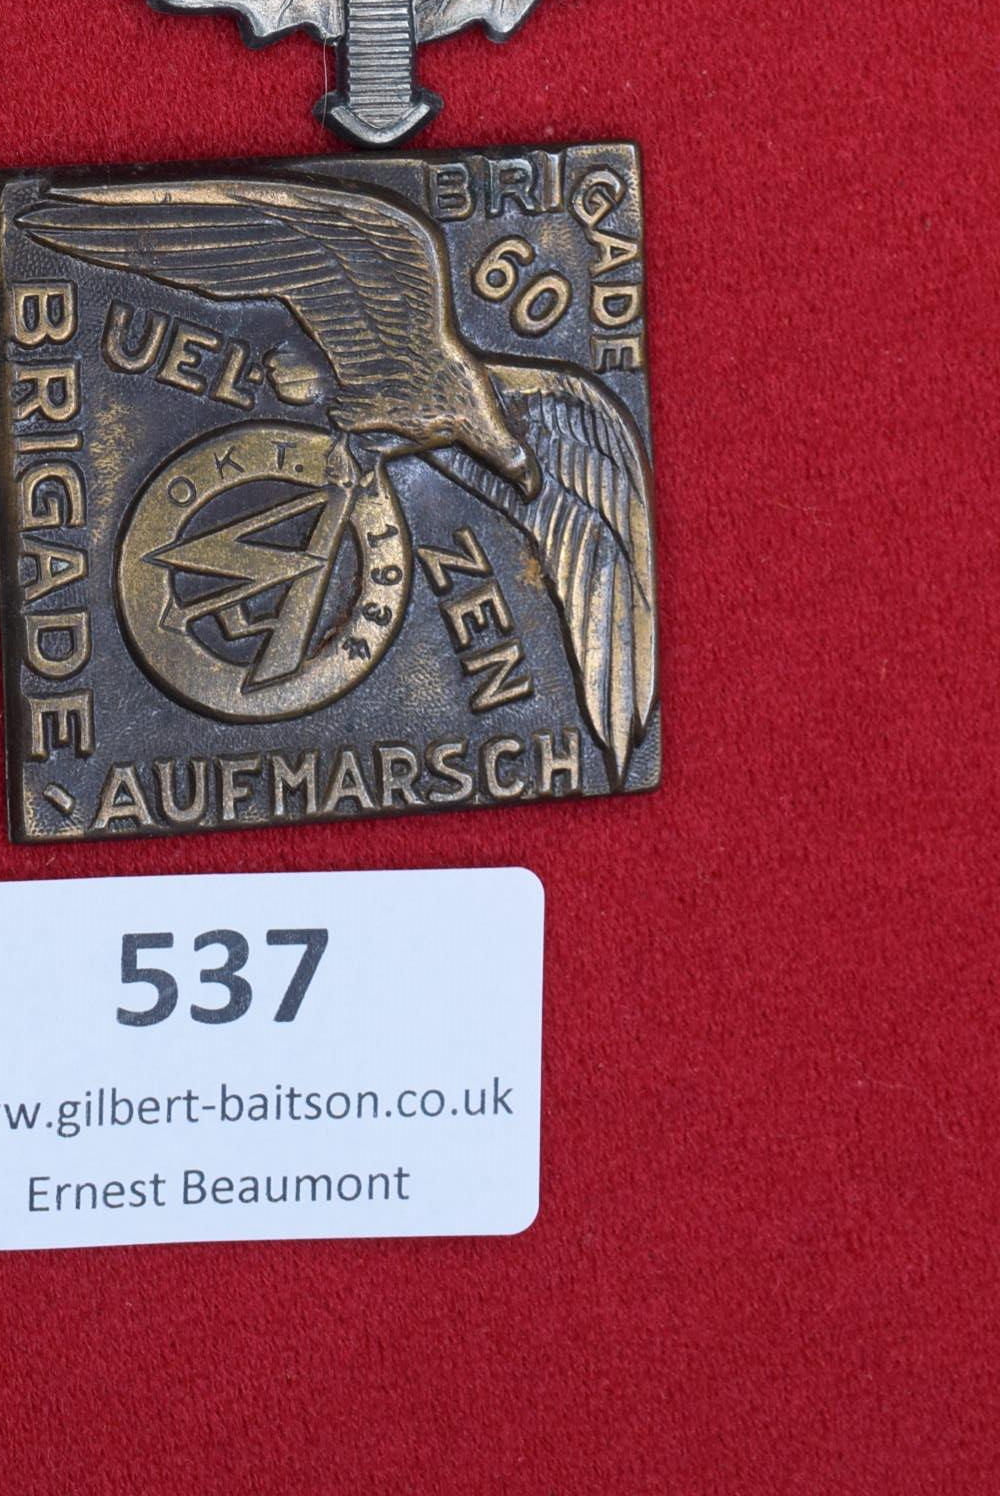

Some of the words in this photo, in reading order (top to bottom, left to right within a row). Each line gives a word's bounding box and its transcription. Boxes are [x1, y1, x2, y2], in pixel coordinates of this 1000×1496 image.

[428, 149, 641, 372] BRIGADE
[472, 236, 573, 337] 60
[10, 280, 94, 760] BRIGADE
[342, 522, 404, 660] 1934
[93, 730, 584, 832] AUFMARSCH
[116, 927, 329, 1028] 537
[28, 1170, 166, 1213] Ernest
[182, 1165, 411, 1205] Beaumont
